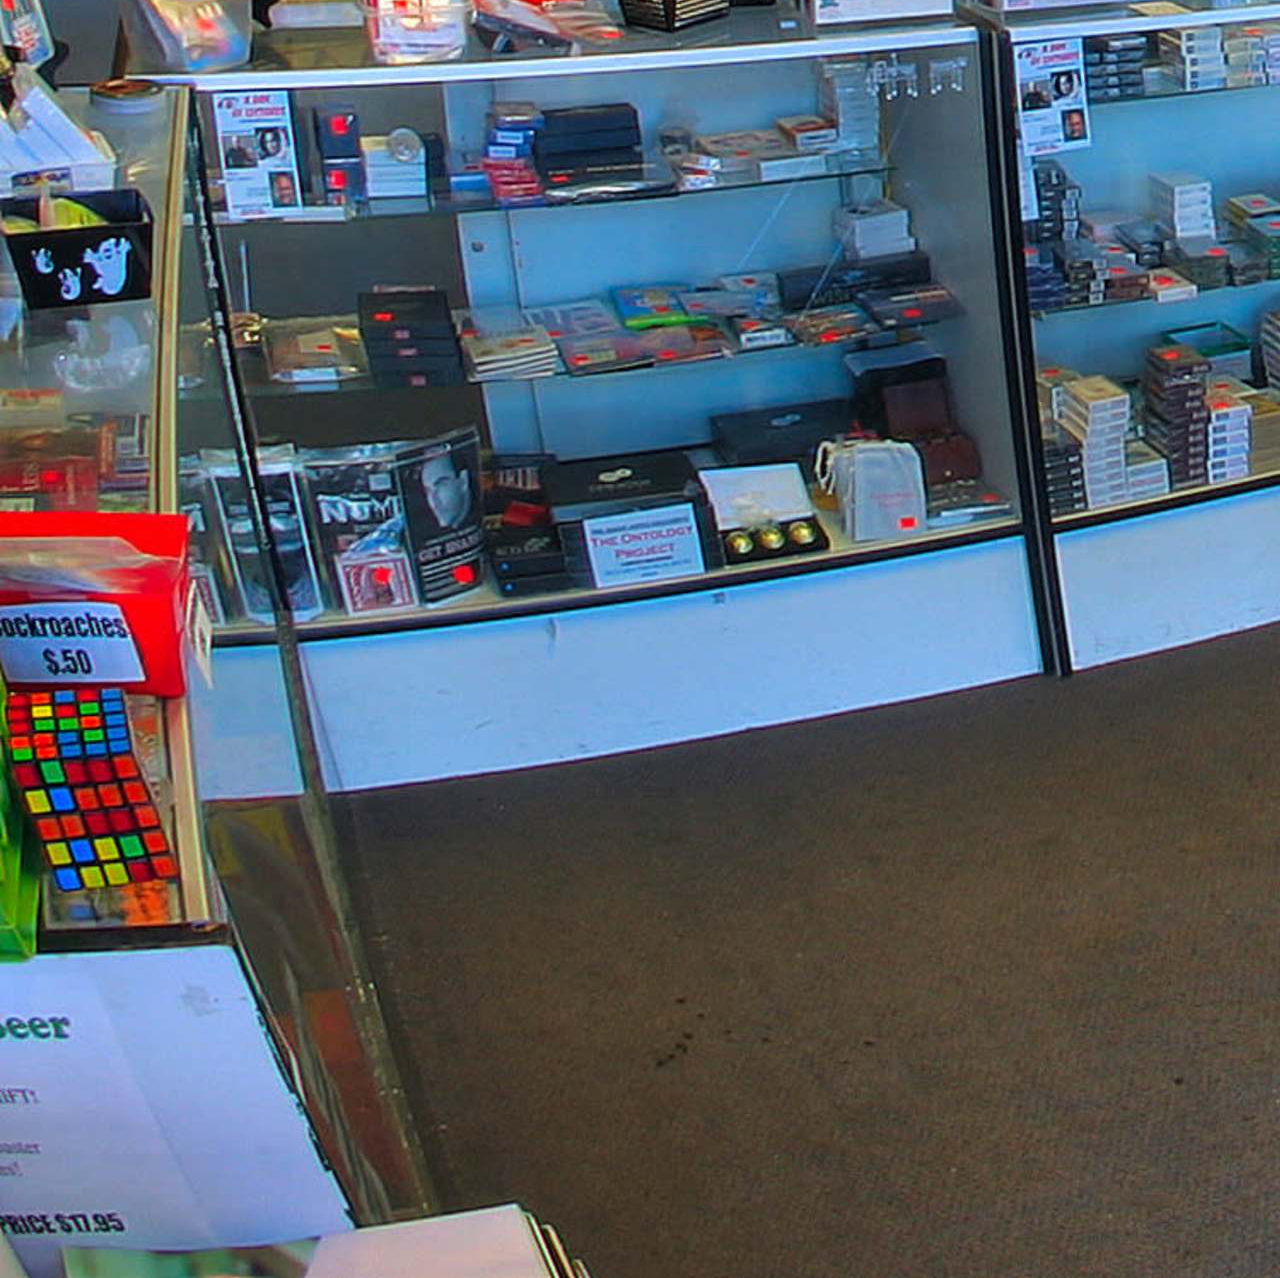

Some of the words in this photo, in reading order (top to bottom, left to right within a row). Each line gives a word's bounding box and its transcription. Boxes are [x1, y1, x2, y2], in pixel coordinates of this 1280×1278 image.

[590, 536, 618, 547] THE
[620, 525, 692, 544] ONTOLOGY
[0, 613, 128, 638] ockroaches
[42, 648, 92, 675] $.50
[54, 1212, 125, 1233] $17.95
